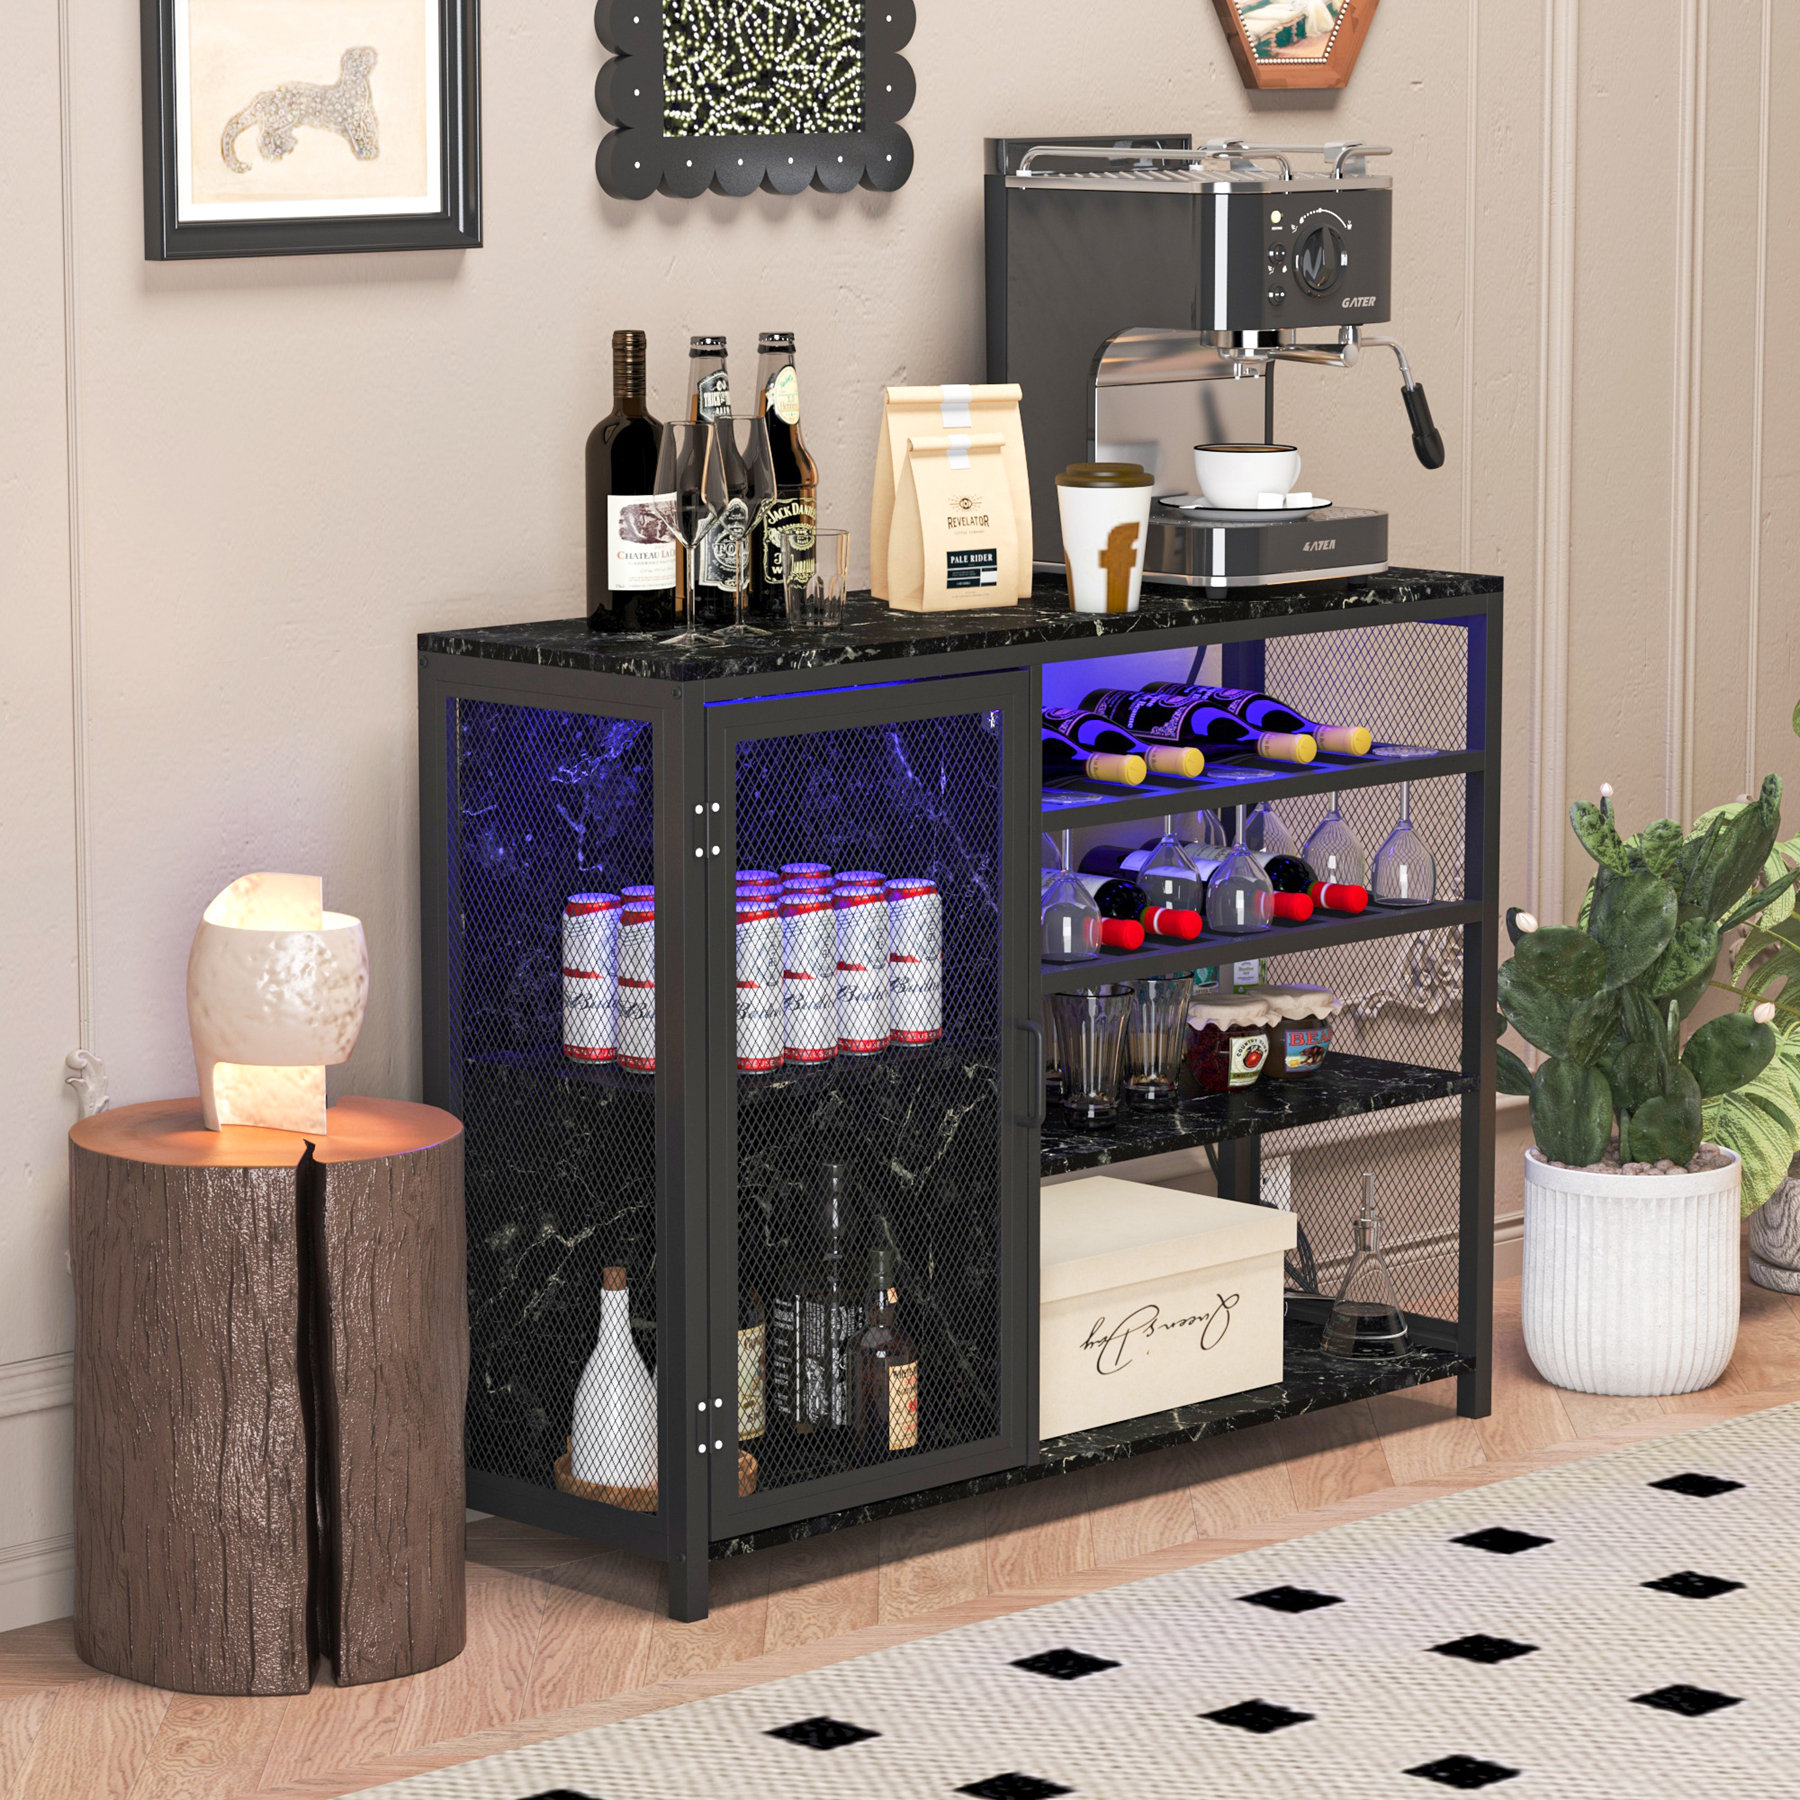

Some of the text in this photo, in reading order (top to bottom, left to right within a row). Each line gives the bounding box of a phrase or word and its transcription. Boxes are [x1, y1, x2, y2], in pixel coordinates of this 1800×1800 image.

[1341, 296, 1377, 308] GATER
[767, 505, 793, 525] JACK
[947, 514, 990, 529] REVELATOR
[950, 553, 994, 564] PALE RIDER
